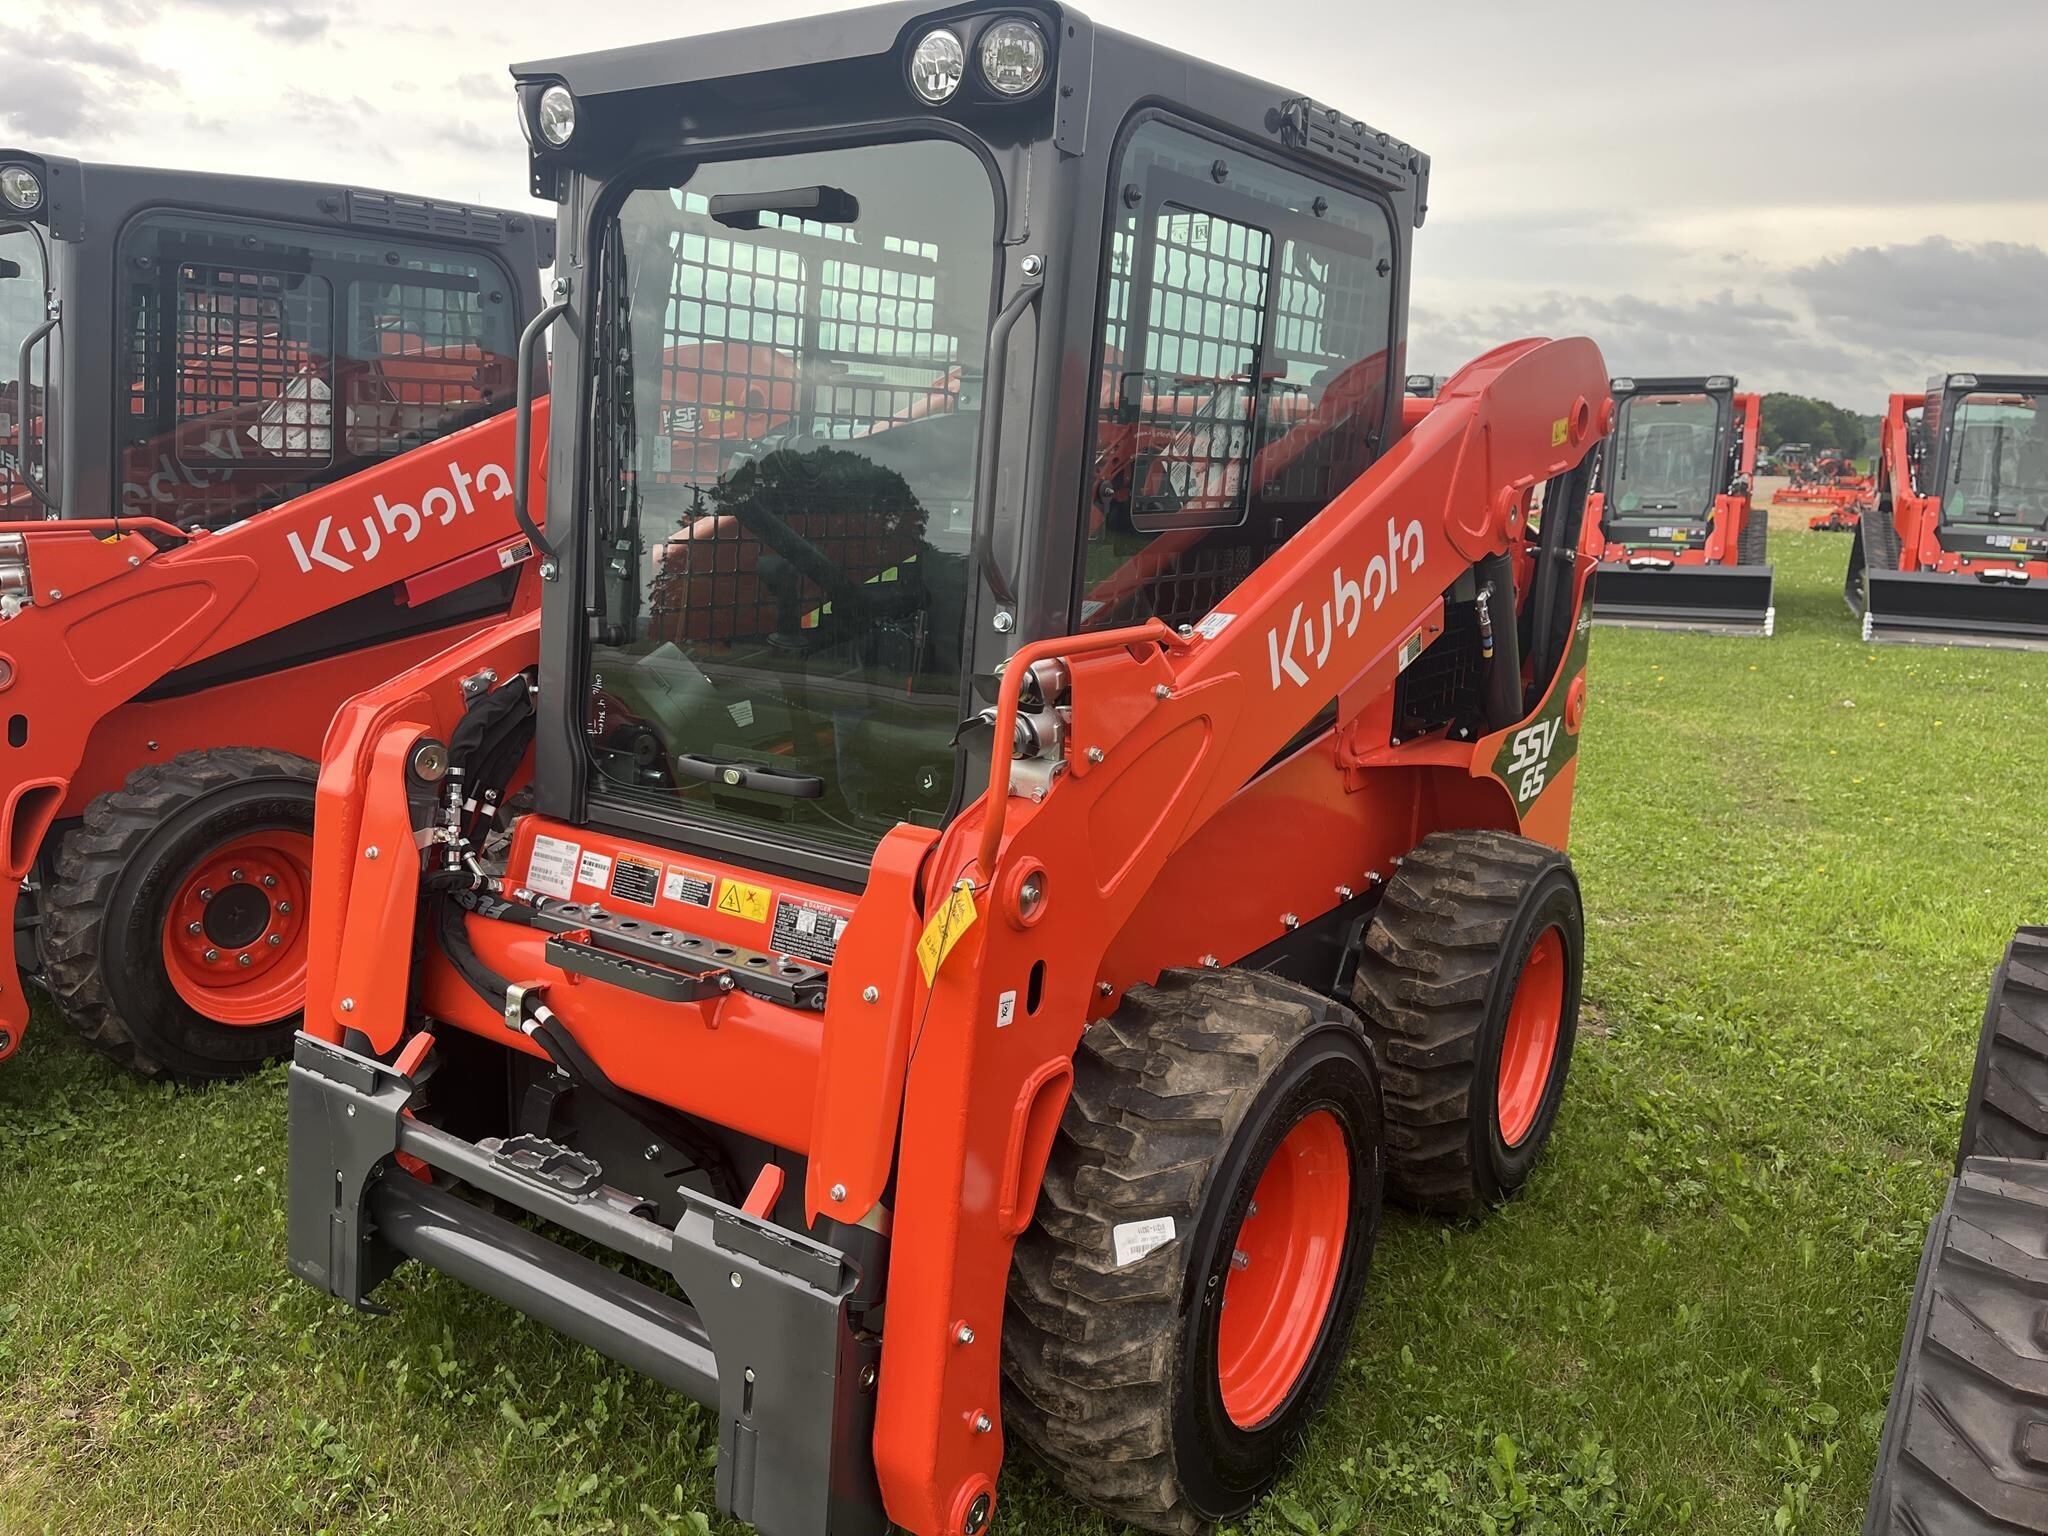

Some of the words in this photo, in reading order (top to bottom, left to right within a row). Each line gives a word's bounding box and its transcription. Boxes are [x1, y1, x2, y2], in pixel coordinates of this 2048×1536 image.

[286, 461, 513, 574] Kubota
[1268, 516, 1425, 692] Kubota
[1508, 716, 1562, 775] SSV
[1519, 761, 1548, 803] 65
